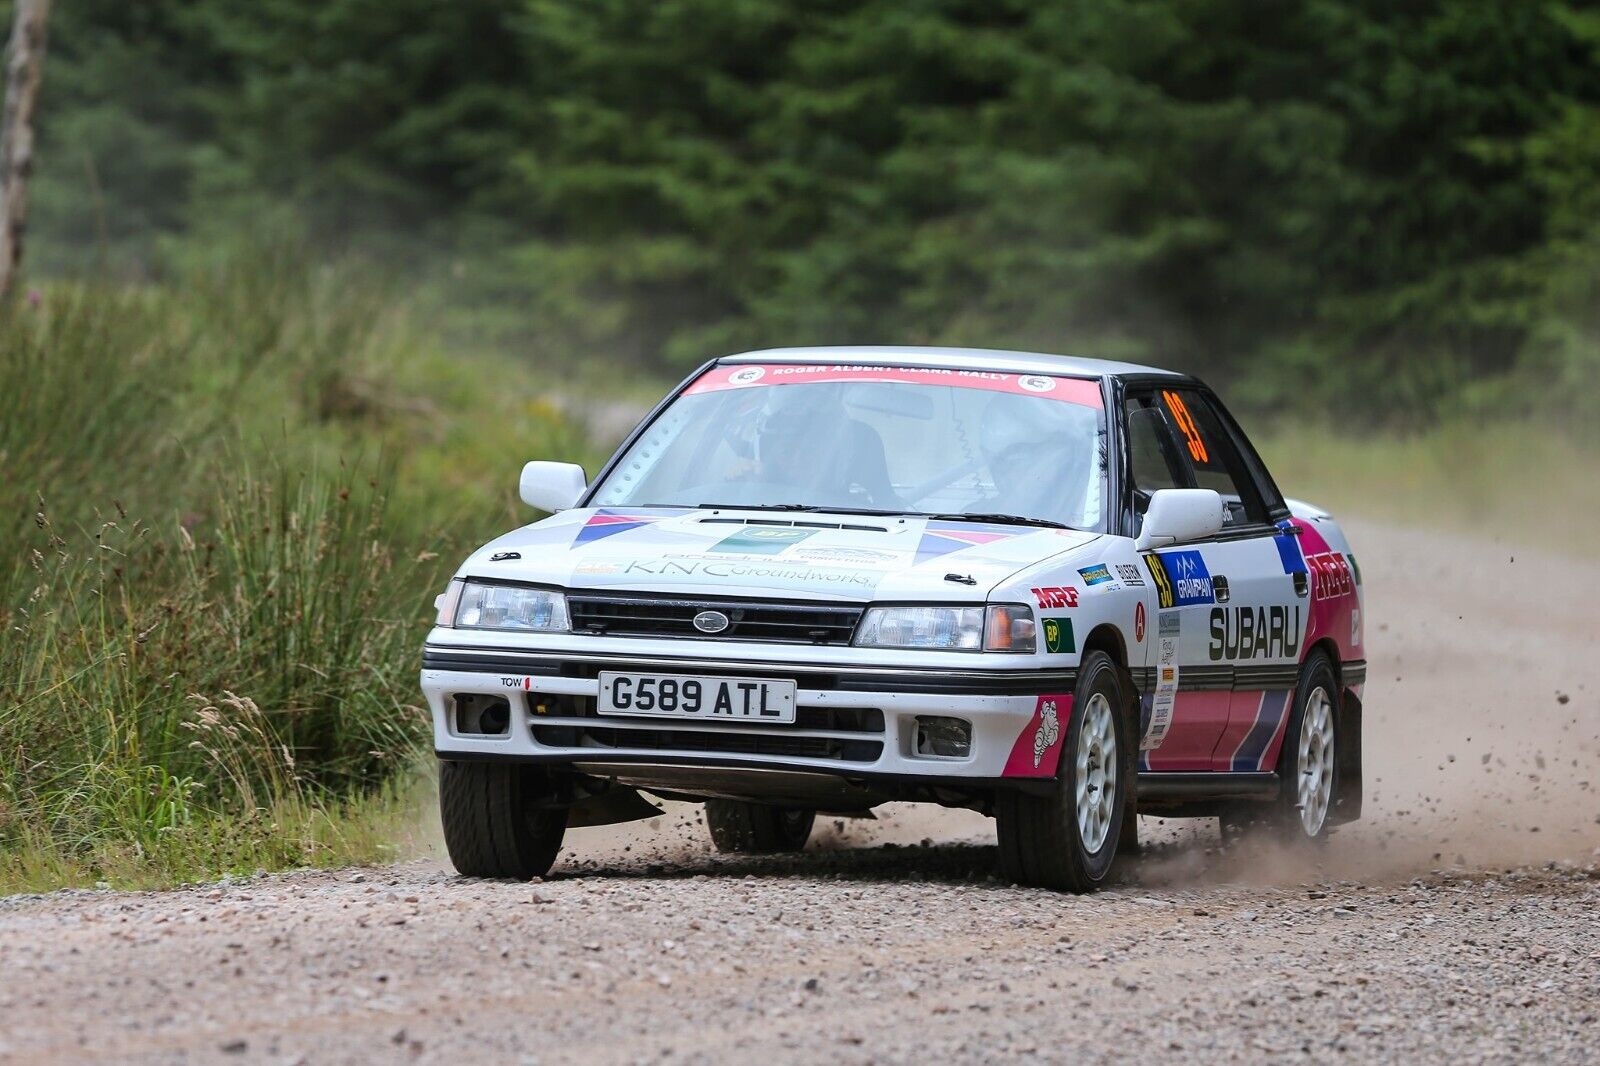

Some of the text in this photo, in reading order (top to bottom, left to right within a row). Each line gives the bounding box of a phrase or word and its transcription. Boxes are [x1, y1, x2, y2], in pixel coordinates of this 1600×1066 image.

[1161, 390, 1208, 463] 93
[1030, 586, 1080, 609] MRF
[1146, 554, 1173, 608] 93
[1047, 625, 1058, 642] BP
[1209, 605, 1300, 661] SUBARU
[500, 677, 522, 687] TOW
[612, 676, 781, 717] G589 ATL
